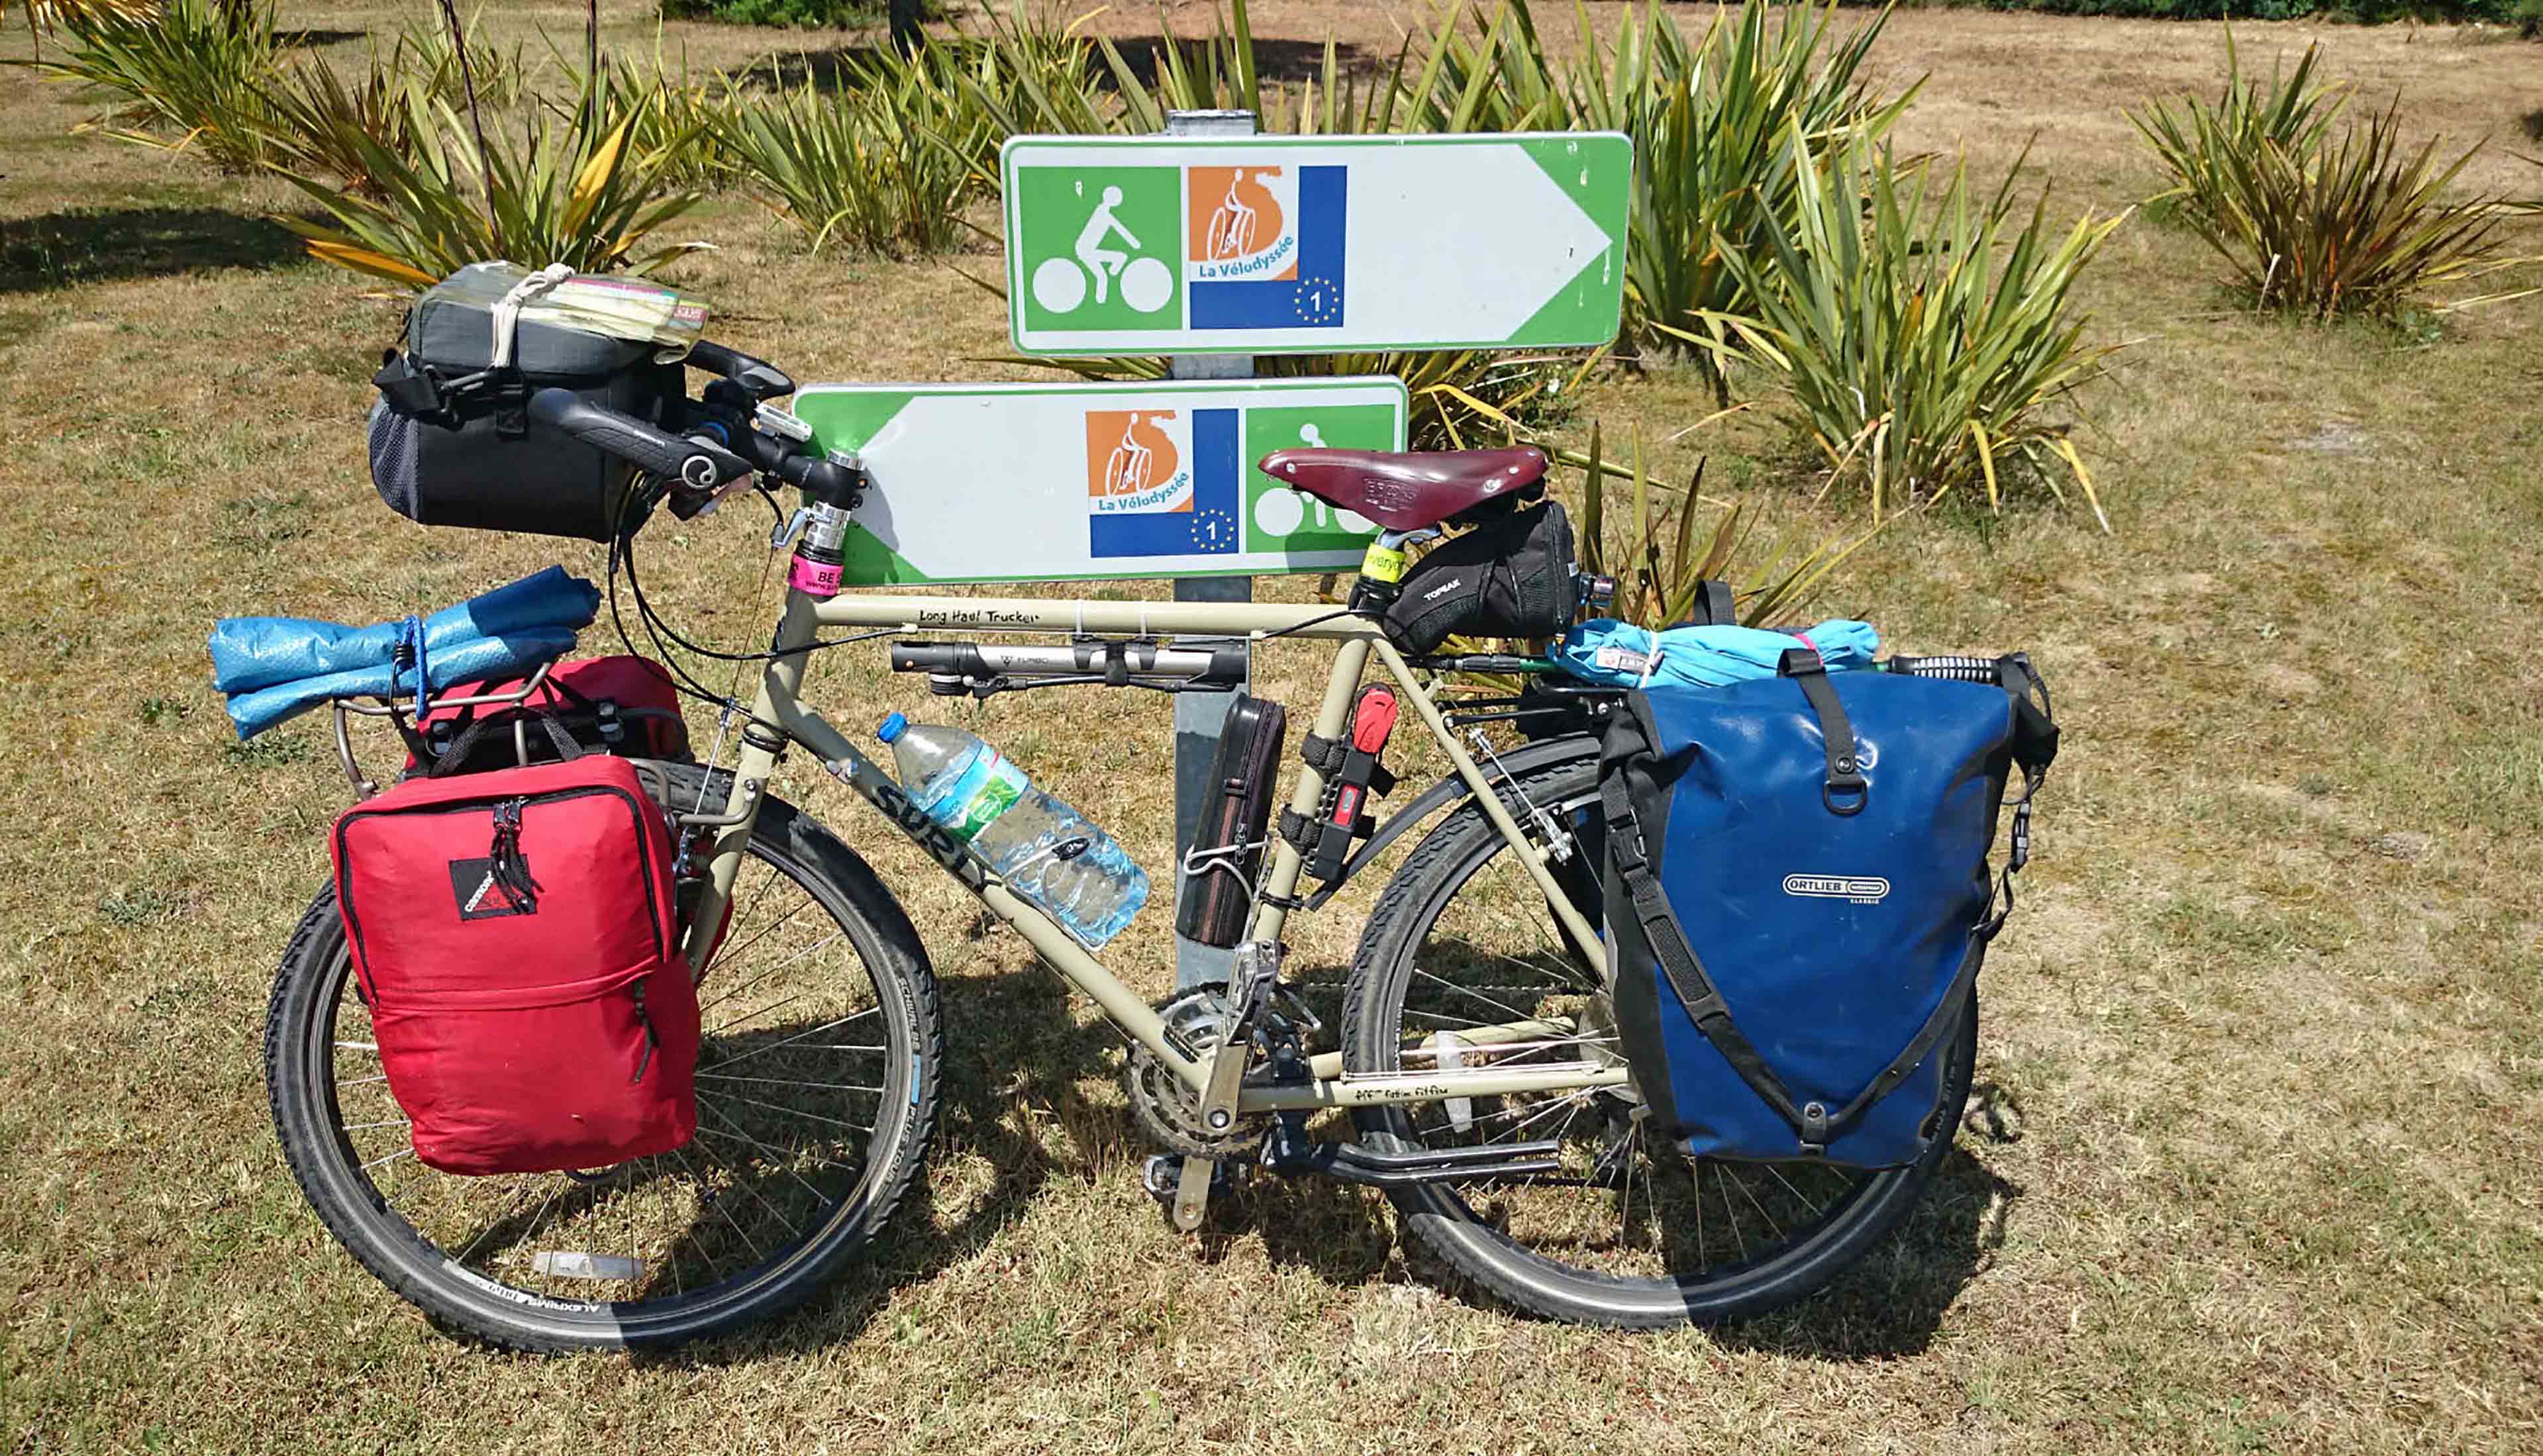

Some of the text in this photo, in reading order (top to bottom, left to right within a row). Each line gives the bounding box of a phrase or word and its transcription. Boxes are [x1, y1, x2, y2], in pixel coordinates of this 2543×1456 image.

[1199, 236, 1294, 277] La Vélodyssée
[1310, 291, 1321, 312] 1
[1099, 472, 1189, 510] La Vélodyssée
[1206, 521, 1217, 540] 1
[1423, 578, 1461, 601] TOPEAK
[919, 609, 1040, 624] Long Haul Trucker
[1789, 879, 1842, 891] ORTLIEB
